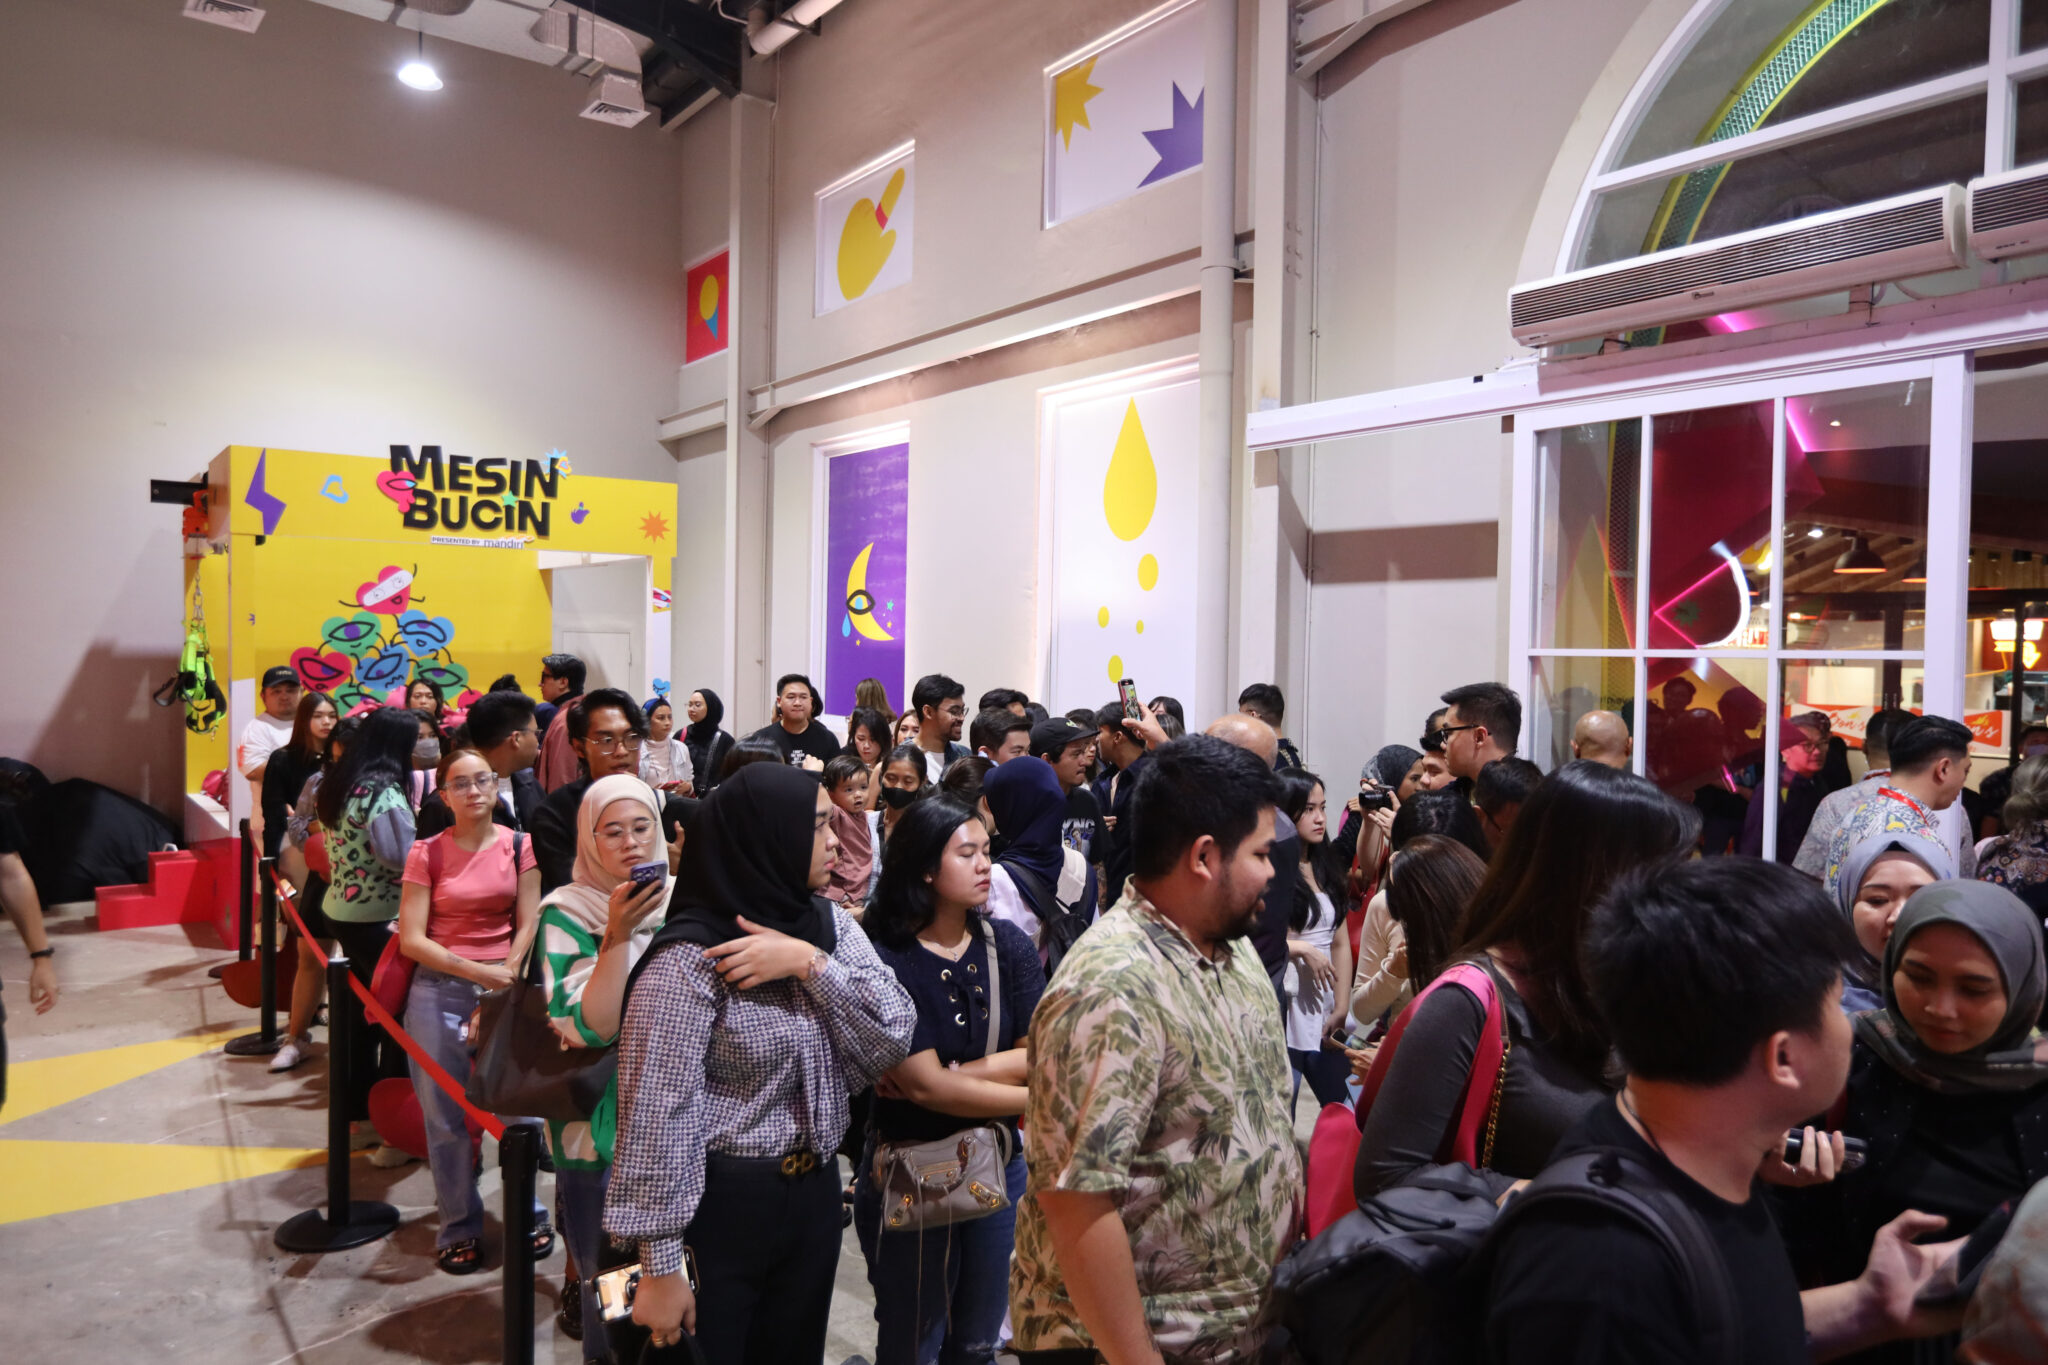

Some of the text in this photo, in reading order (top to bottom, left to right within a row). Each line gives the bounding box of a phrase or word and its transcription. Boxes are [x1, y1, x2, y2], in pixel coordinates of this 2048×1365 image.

[390, 444, 560, 499] MESIN
[403, 488, 550, 539] BUCIN
[431, 536, 471, 545] PRESENTED
[483, 538, 524, 549] mandiri
